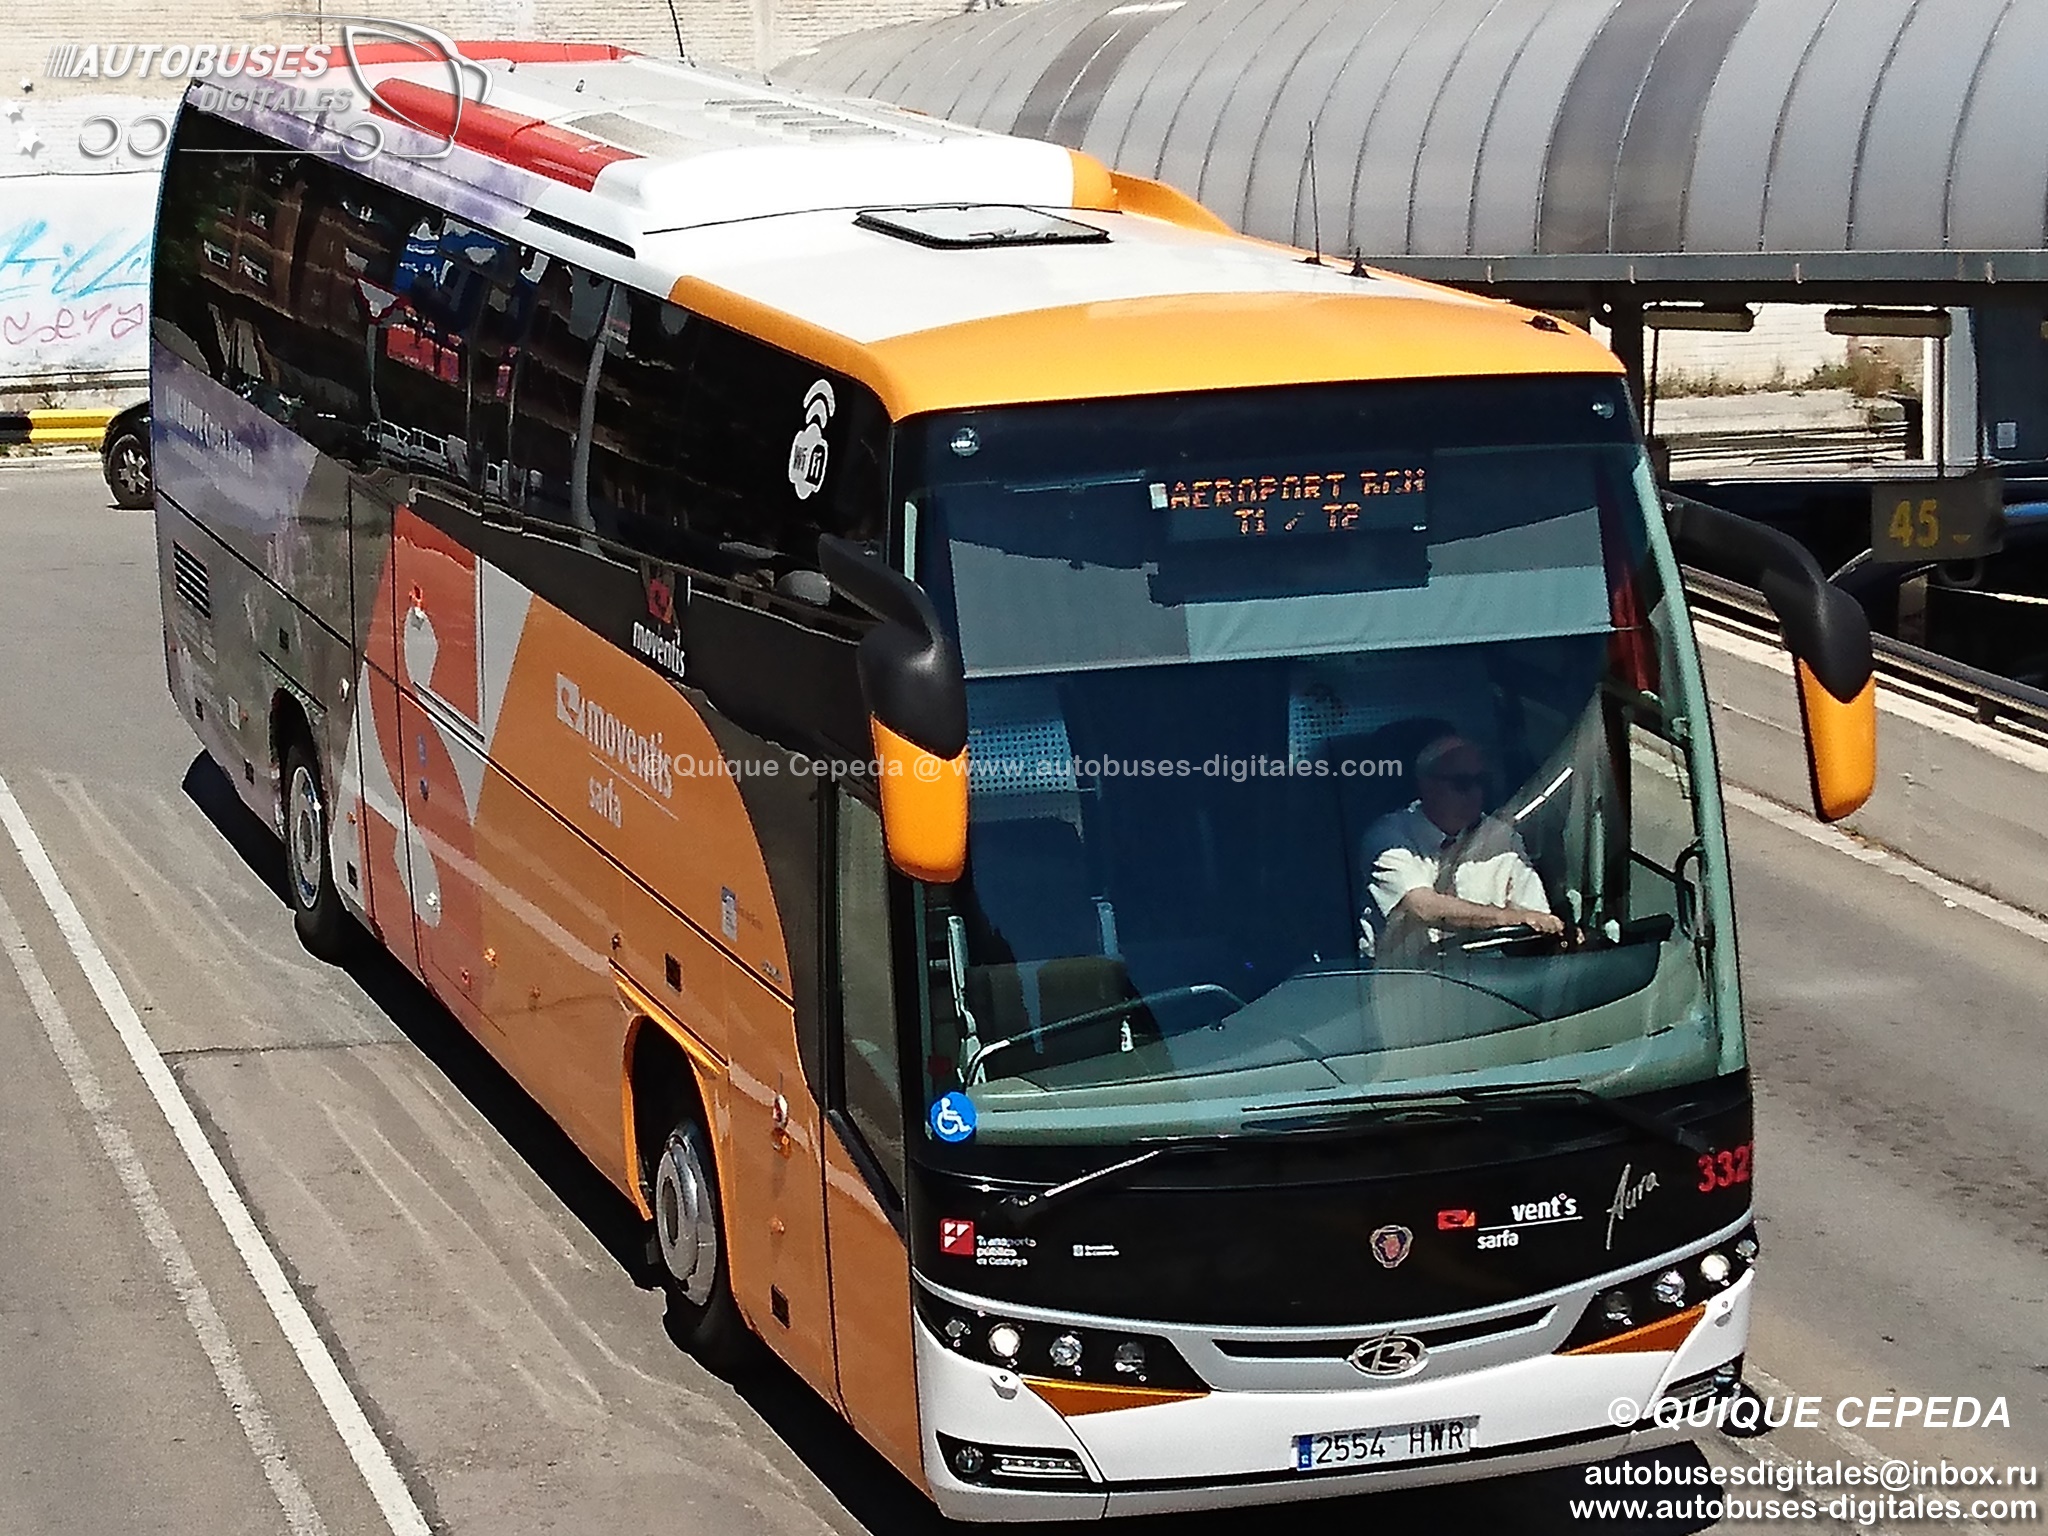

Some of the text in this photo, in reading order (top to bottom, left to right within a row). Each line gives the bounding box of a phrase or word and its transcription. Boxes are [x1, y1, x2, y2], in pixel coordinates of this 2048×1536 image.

[1889, 499, 1939, 547] 45
[632, 621, 686, 678] moventis
[586, 699, 673, 800] moventis
[1476, 1230, 1520, 1250] sarfa
[1316, 1421, 1464, 1465] 2554 HWR
